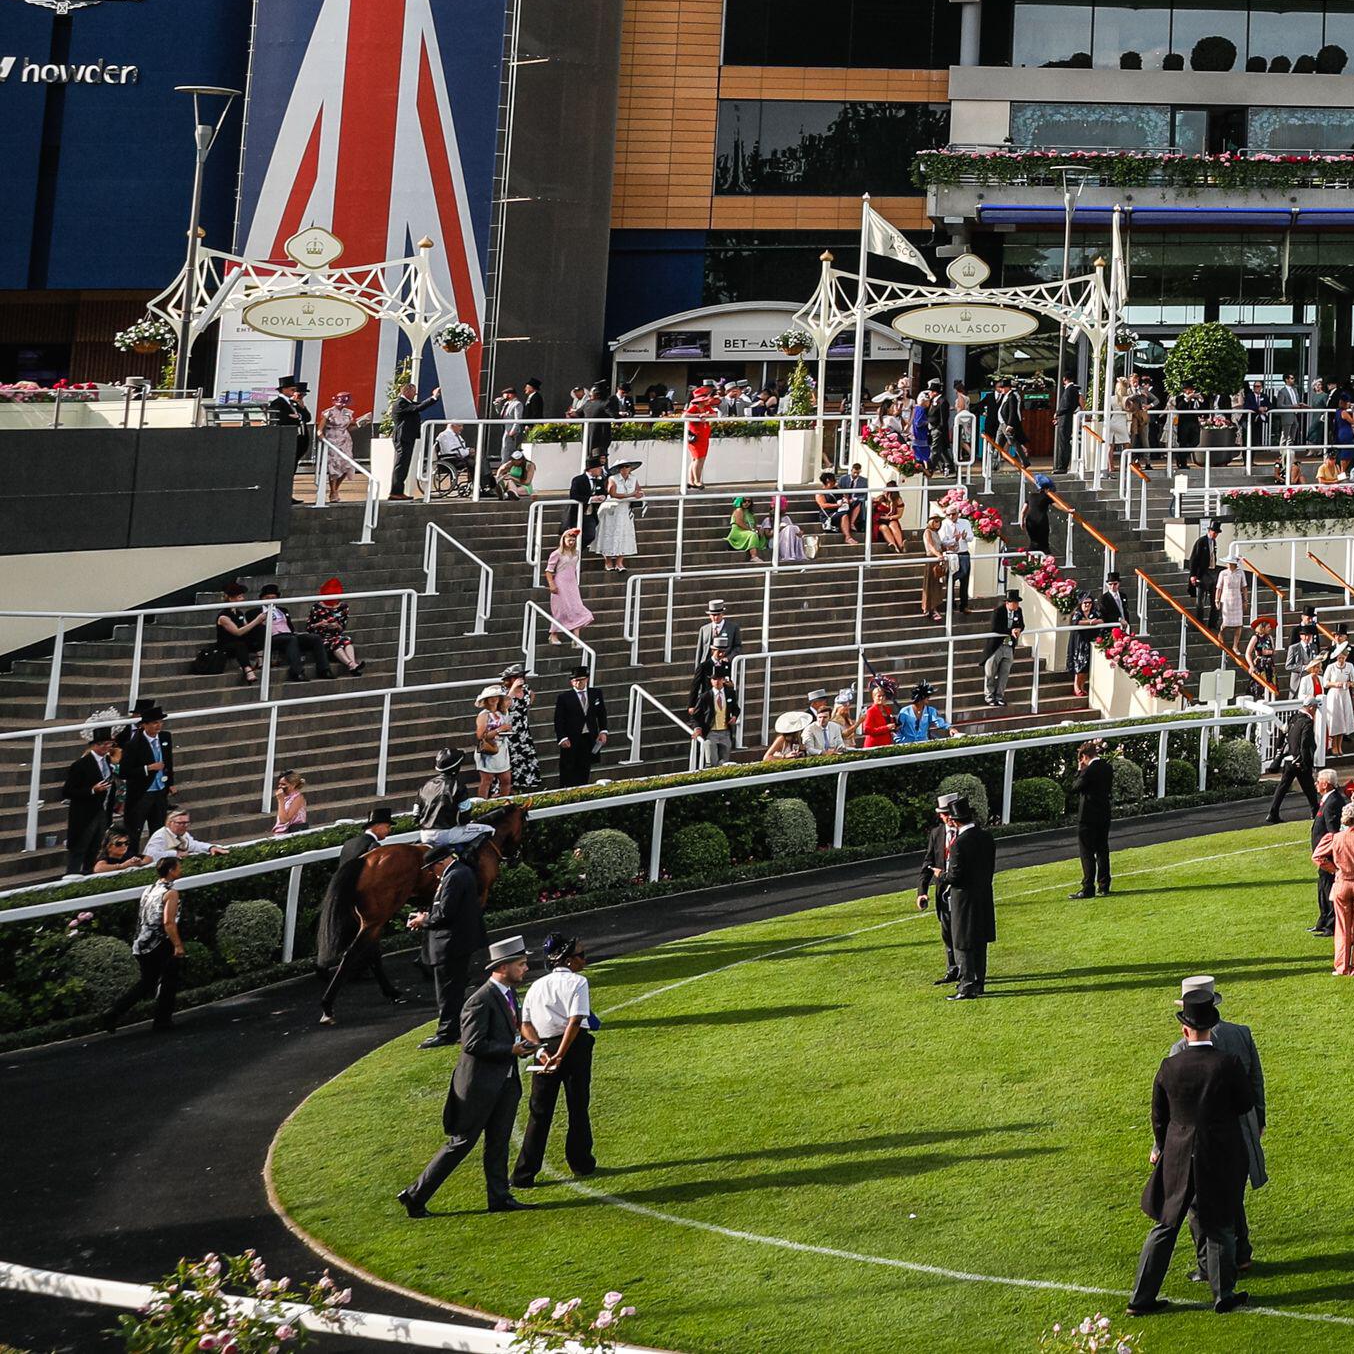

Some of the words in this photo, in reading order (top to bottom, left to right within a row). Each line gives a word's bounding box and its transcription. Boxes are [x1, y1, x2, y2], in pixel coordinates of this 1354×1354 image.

[21, 56, 139, 84] howden
[889, 243, 919, 260] ASCO
[261, 316, 302, 326] ROYAL
[308, 317, 352, 327] ASCOT
[924, 324, 962, 334] ROYAL
[966, 324, 1007, 334] ASCOT
[724, 339, 748, 348] BET
